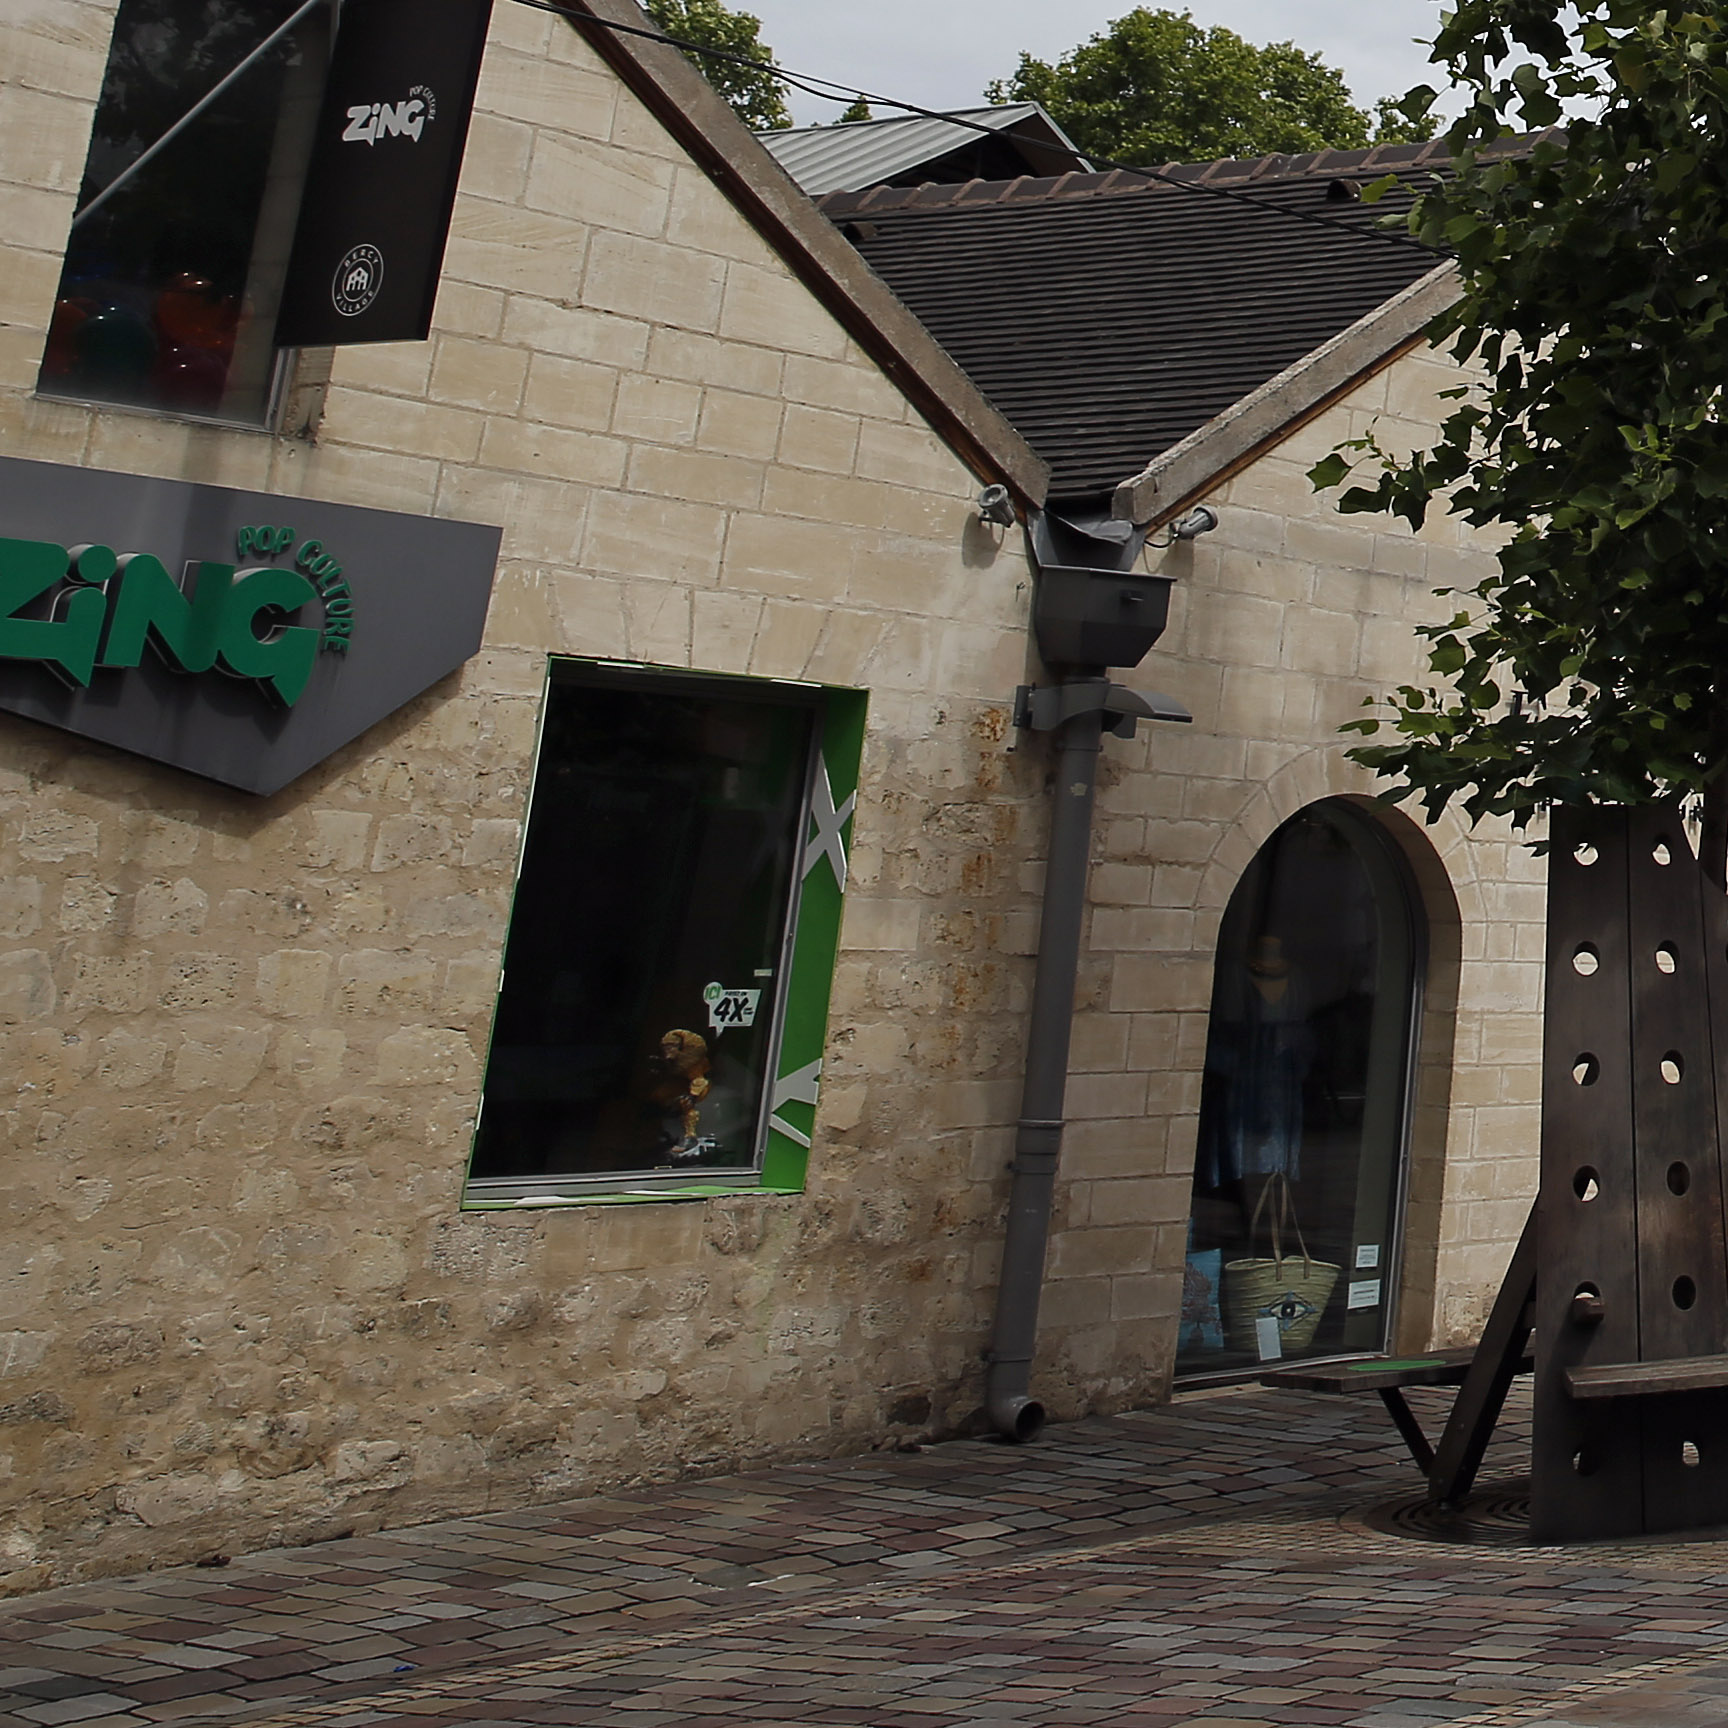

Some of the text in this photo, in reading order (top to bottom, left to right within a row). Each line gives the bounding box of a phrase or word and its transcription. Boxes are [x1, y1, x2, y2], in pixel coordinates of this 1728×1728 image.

[344, 249, 379, 268] BERCY
[336, 291, 374, 312] VILLAGE
[238, 525, 356, 653] POP CULTURE
[713, 997, 749, 1023] 4X
